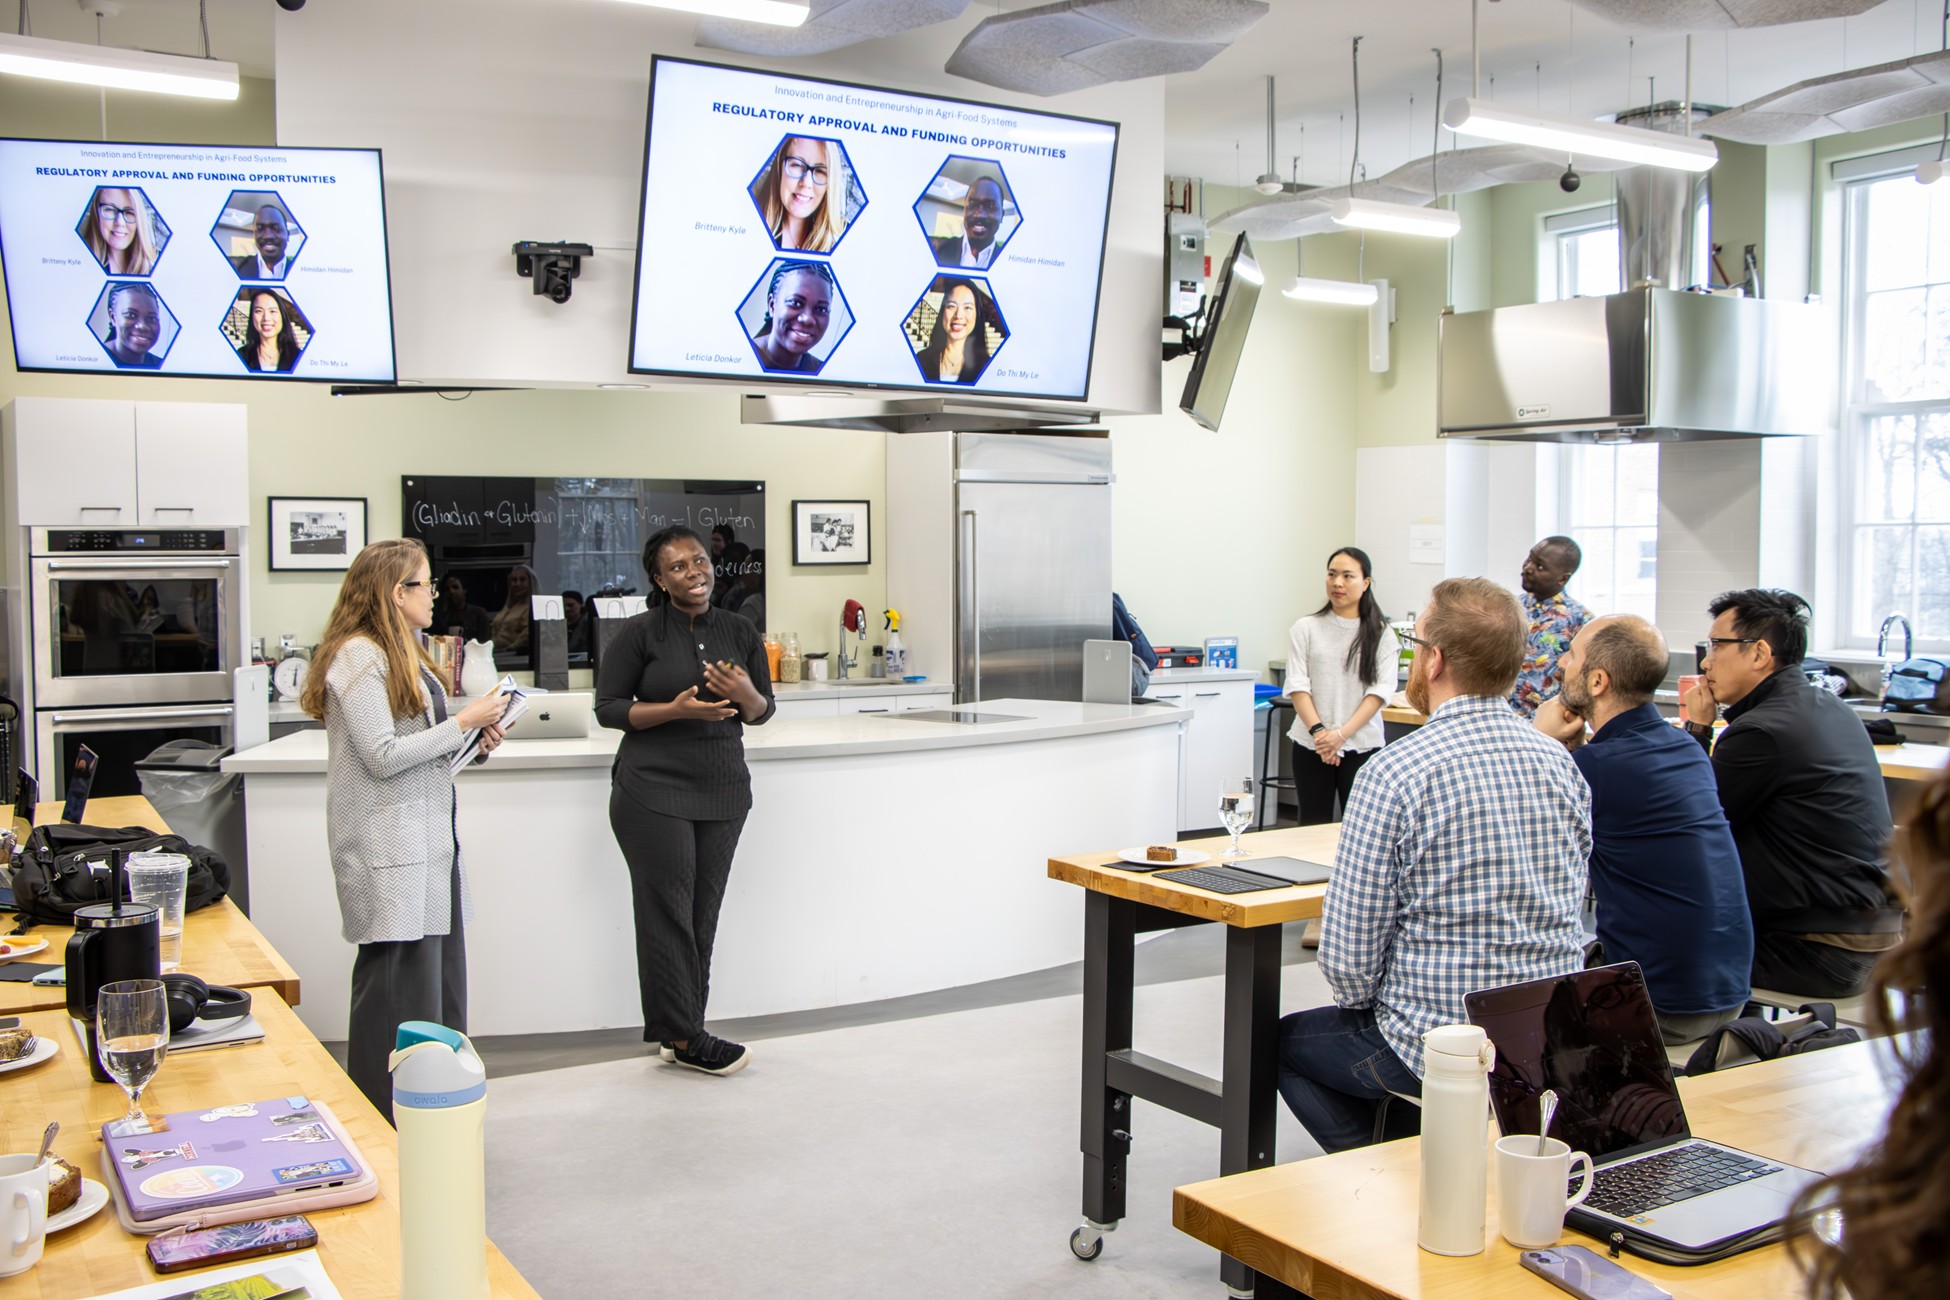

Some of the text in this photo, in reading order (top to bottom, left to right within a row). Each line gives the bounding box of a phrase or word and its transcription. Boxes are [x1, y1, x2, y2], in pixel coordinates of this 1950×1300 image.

[775, 85, 1017, 128] Innovation and Entrepreneurship in Agri-Food Systems
[713, 102, 1065, 158] REGULATORY APPROVAL AND FUNDING OPPORTUNITIES
[80, 150, 121, 159] Innovation
[122, 152, 137, 160] and
[138, 152, 204, 162] Entrepreneurship
[214, 154, 252, 163] Agri-Food
[253, 154, 287, 164] Systems
[36, 167, 336, 183] REGULATORY APPROVAL AND FUNDING OPPORTUNITIES
[695, 222, 746, 234] Britteny Kyle
[41, 256, 82, 267] Britteny Kyle
[1008, 254, 1065, 267] Himidan Himidan
[55, 354, 99, 363] Leticia Donkor
[686, 353, 742, 364] Leticia Donkor
[1019, 371, 1029, 379] My
[698, 506, 757, 531] Gluten
[414, 1094, 448, 1105] owala
